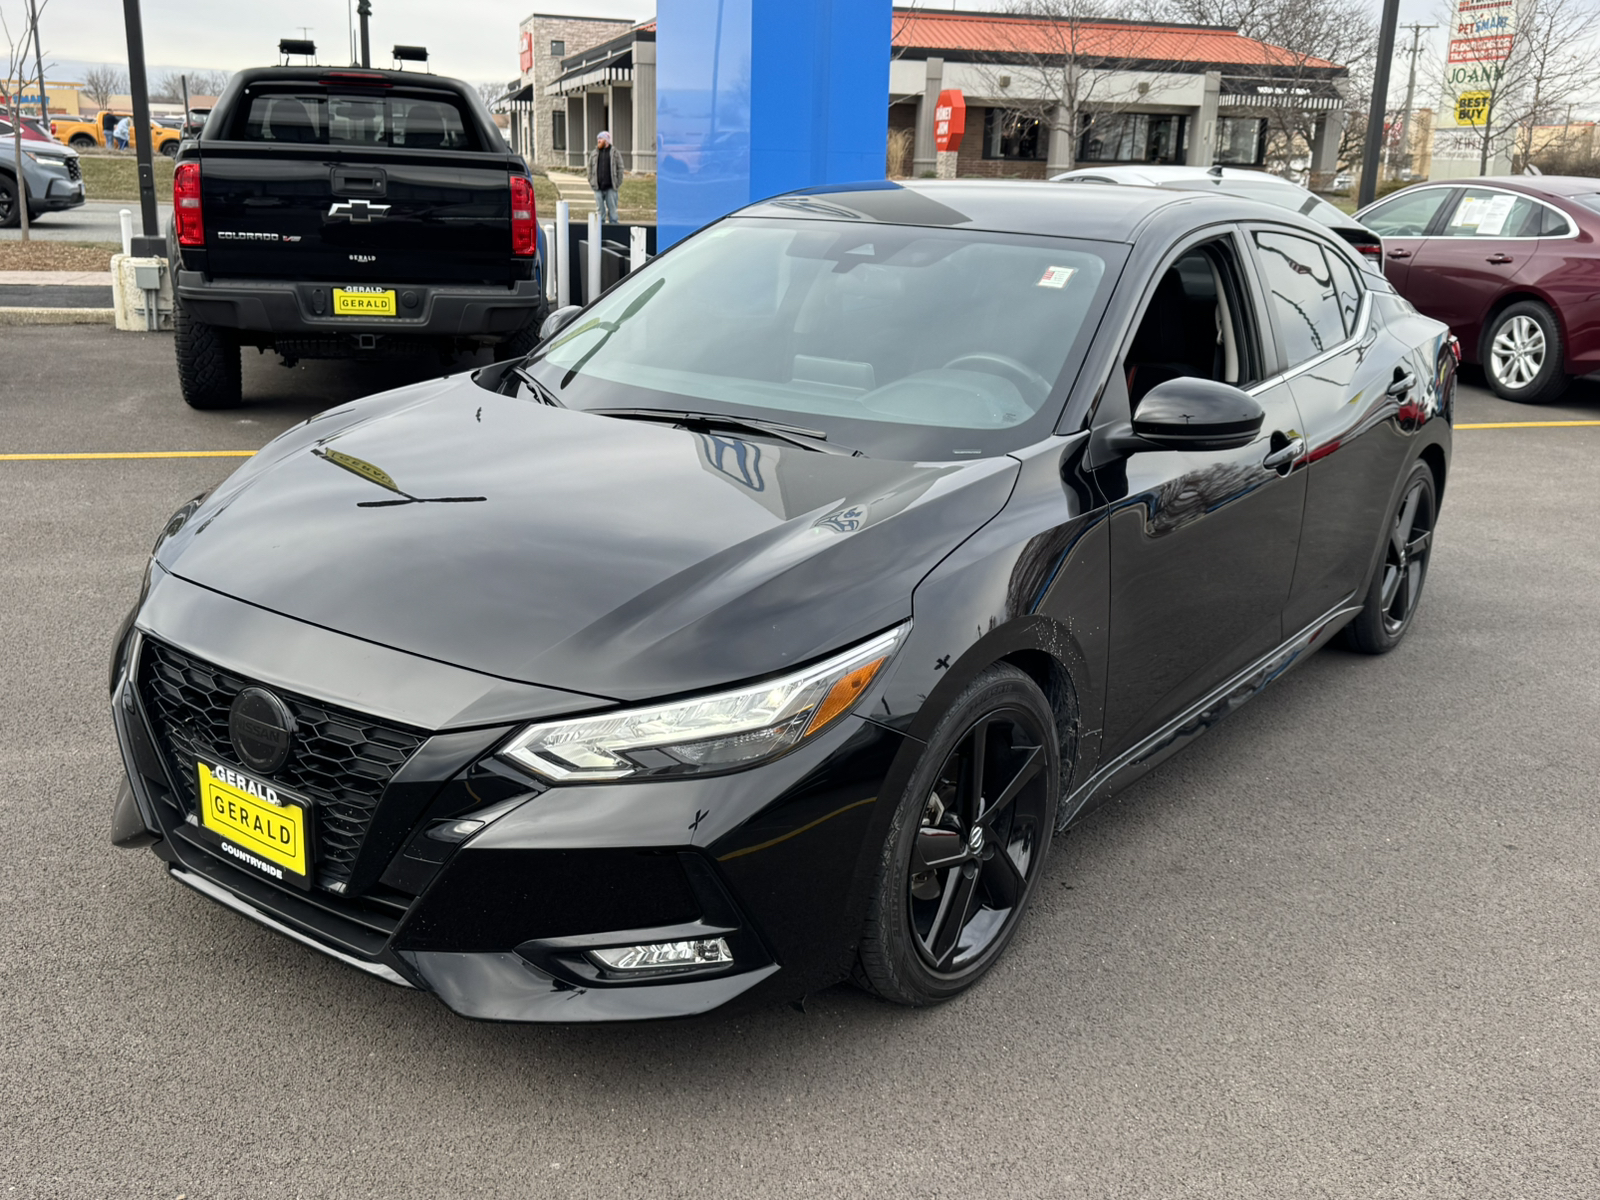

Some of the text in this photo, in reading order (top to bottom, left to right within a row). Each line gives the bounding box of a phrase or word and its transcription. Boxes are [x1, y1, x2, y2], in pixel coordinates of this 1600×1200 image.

[1460, 97, 1489, 108] BEST
[1459, 108, 1484, 120] BUY
[218, 231, 279, 241] COLORADO
[349, 254, 376, 262] GERALD
[346, 285, 383, 293] GERALD
[342, 299, 388, 308] GERALD
[236, 718, 281, 743] NISSAN
[215, 764, 278, 804] GERALD
[214, 795, 291, 845] GERALD
[221, 841, 283, 880] COUNTRYSIDE
